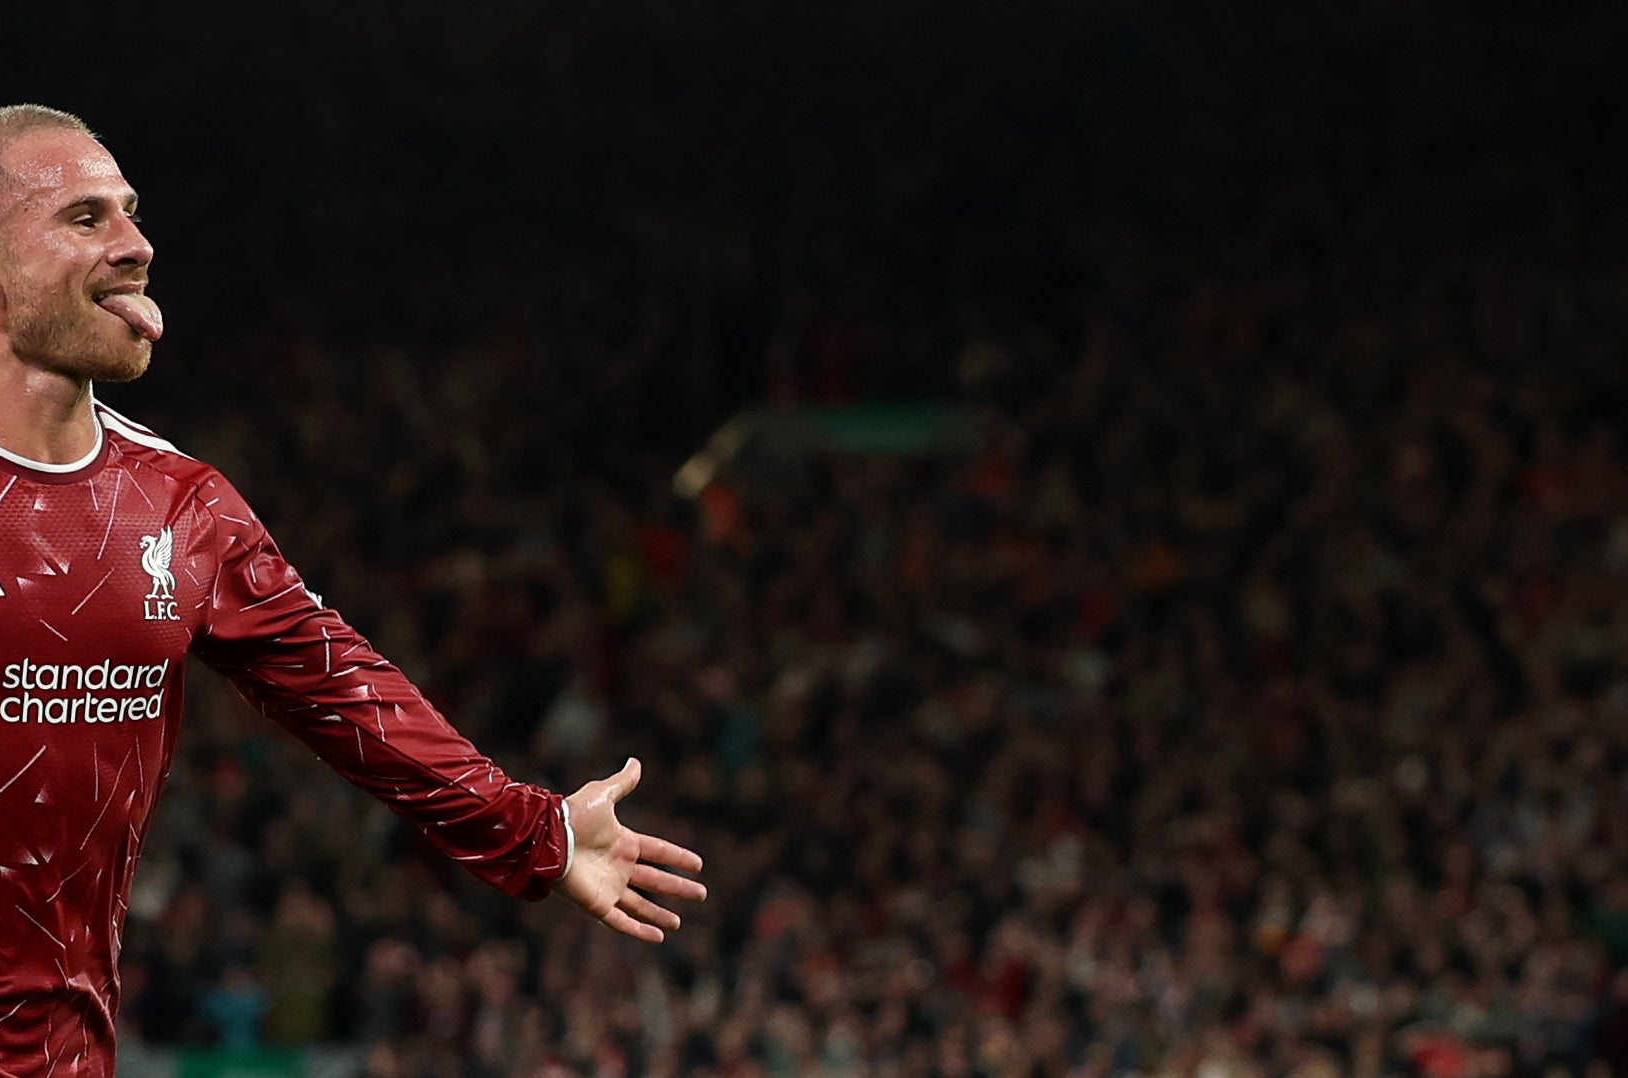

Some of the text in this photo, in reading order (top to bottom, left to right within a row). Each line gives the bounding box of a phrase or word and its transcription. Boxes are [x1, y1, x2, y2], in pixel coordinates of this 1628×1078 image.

[143, 600, 181, 621] L.F.C.
[1, 657, 169, 690] standard
[0, 688, 166, 724] chartered
